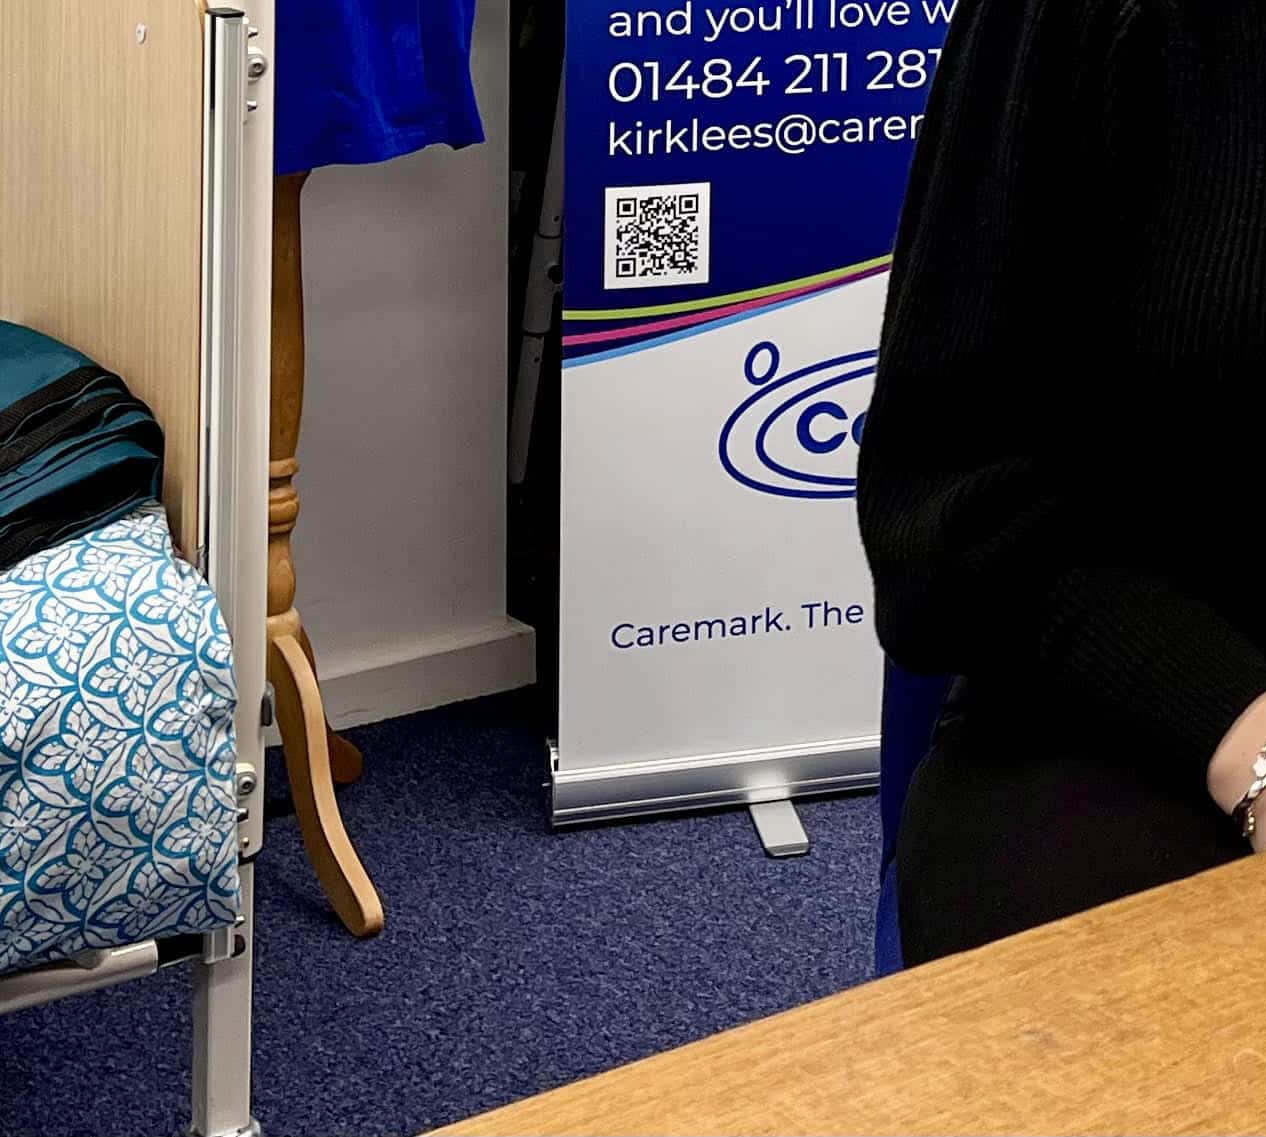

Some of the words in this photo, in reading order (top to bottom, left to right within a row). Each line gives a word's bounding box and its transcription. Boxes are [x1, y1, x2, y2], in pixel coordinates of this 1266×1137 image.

[608, 1, 692, 37] and
[608, 56, 770, 103] 01484
[784, 50, 849, 95] 211
[611, 607, 791, 650] Caremark.
[801, 601, 864, 629] The
